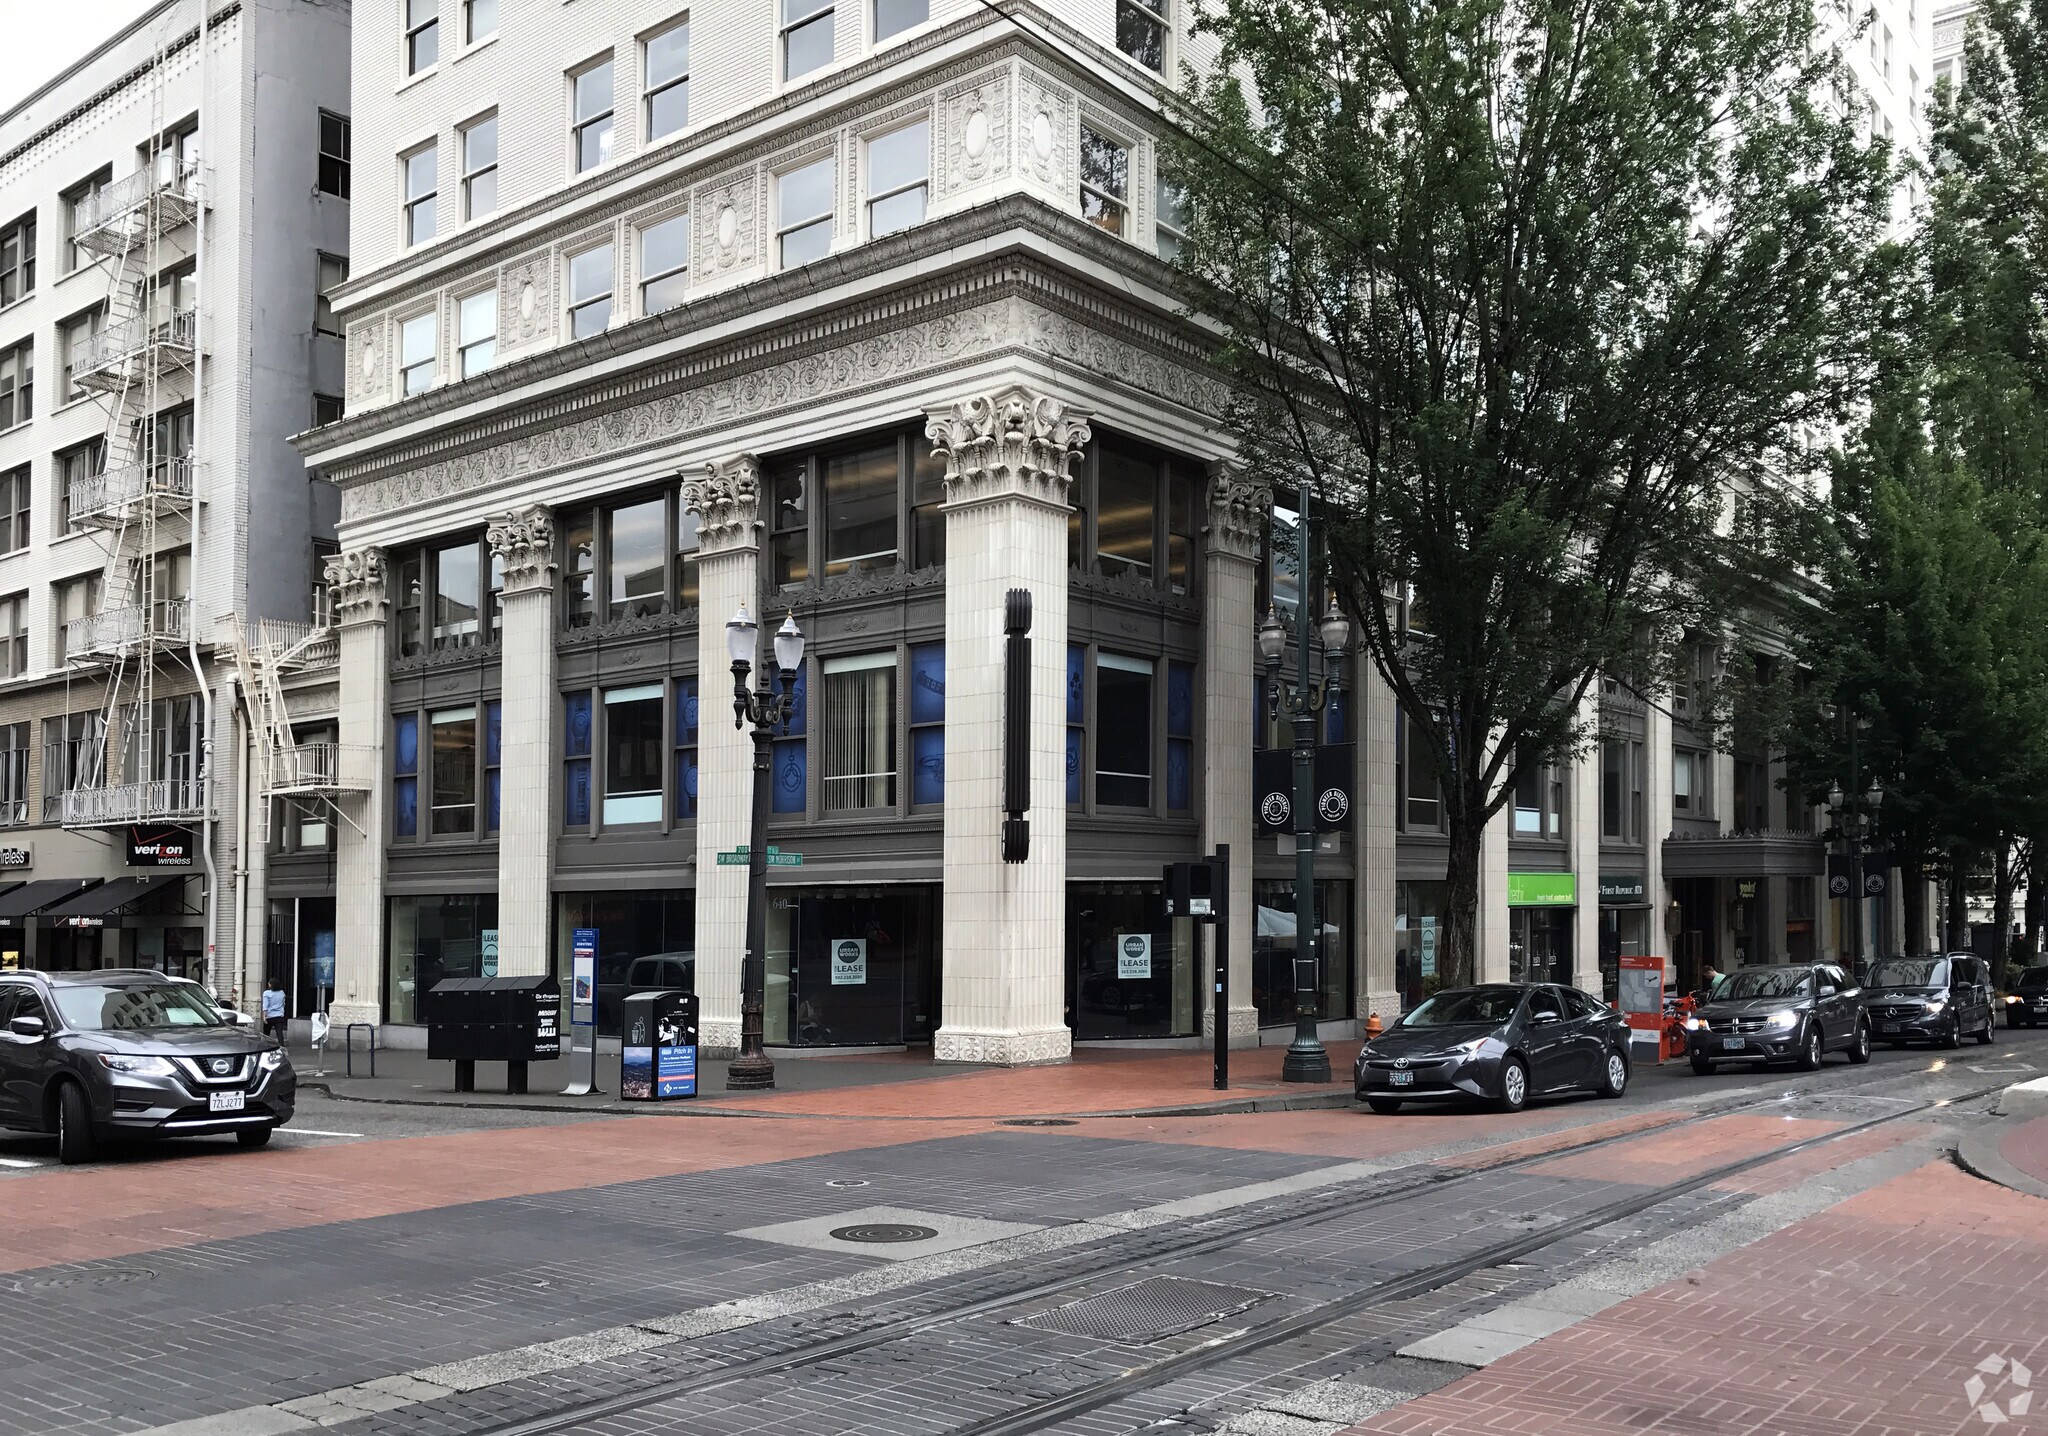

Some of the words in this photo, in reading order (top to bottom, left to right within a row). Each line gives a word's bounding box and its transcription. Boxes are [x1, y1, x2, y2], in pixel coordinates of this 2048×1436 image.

[134, 843, 183, 857] verizon
[157, 856, 191, 865] wireless
[718, 854, 725, 863] SW
[726, 853, 749, 863] BROADWAY
[768, 855, 775, 864] SW
[775, 855, 796, 865] MORRISON
[772, 897, 788, 909] 640
[69, 915, 89, 927] verizon
[484, 934, 498, 942] LEAS
[1123, 959, 1149, 967] LEASE
[837, 964, 864, 973] LEASE
